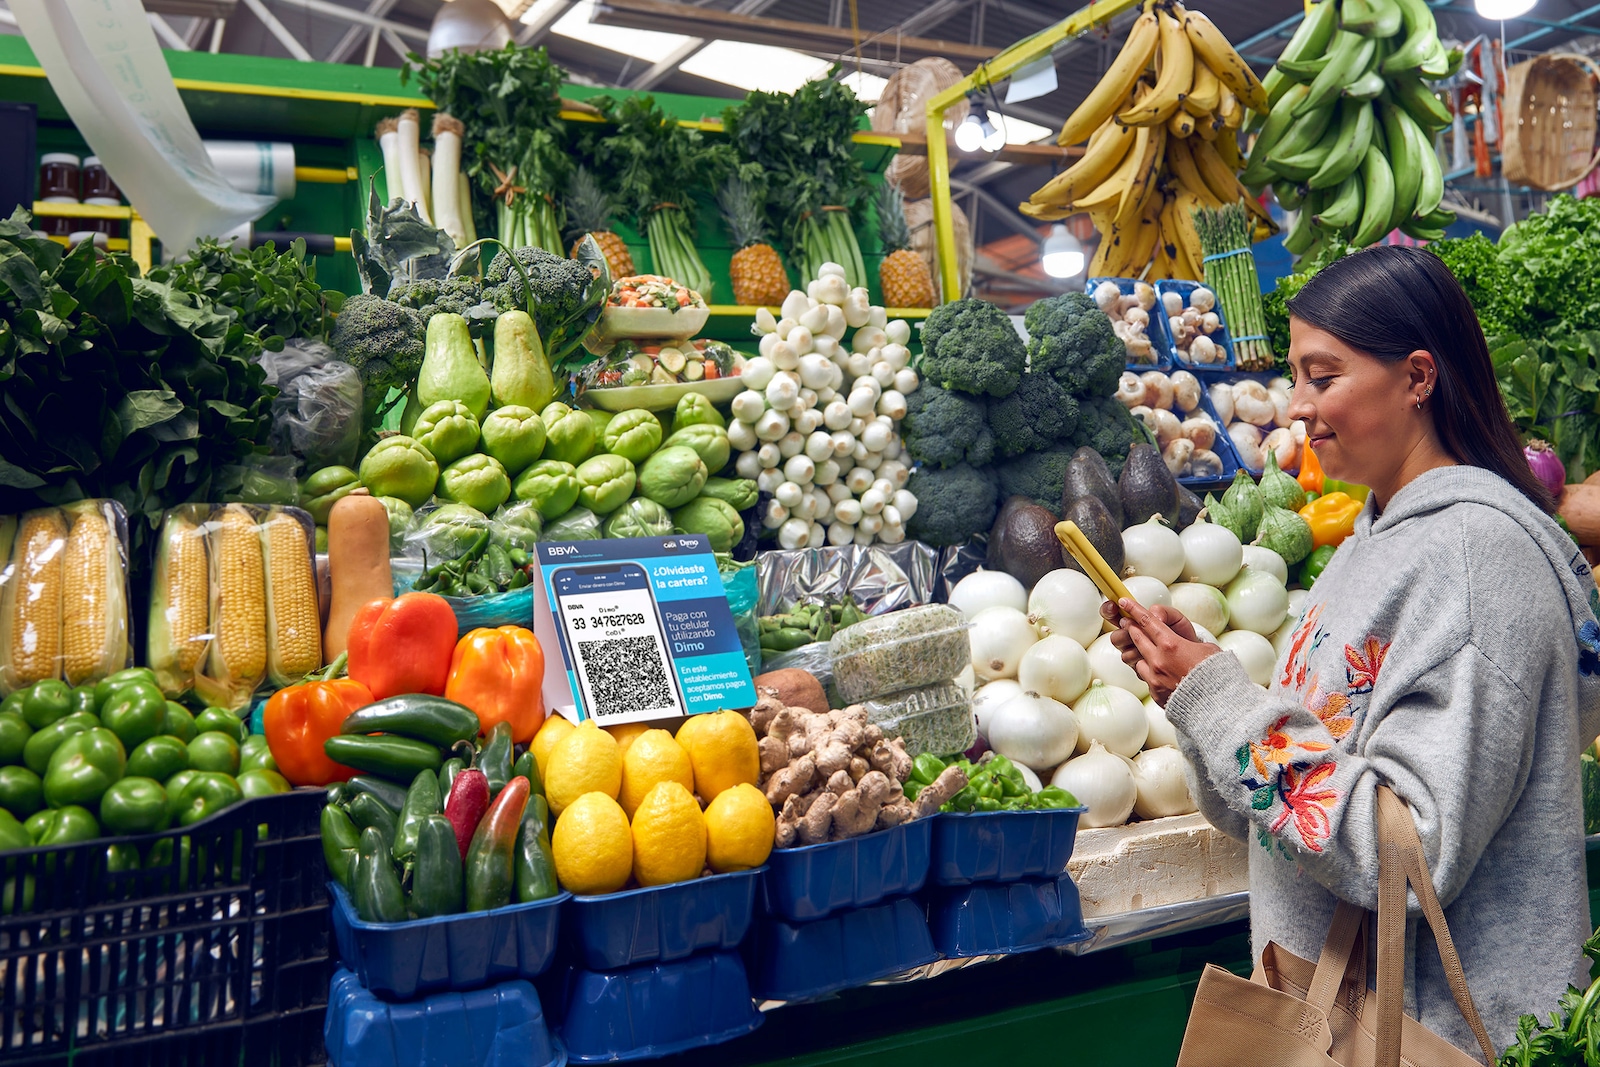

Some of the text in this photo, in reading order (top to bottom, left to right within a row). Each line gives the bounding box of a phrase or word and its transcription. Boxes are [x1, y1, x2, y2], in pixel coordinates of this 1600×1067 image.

[548, 545, 579, 556] BBVA
[653, 564, 705, 577] ¿Olvidaste
[656, 575, 708, 589] la cartera?
[572, 613, 645, 630] 33 347627628
[665, 610, 707, 622] Paga con
[669, 620, 710, 632] tu celular
[671, 628, 715, 641] utilizando
[674, 641, 704, 653] Dimo
[681, 665, 707, 674] En este
[684, 670, 738, 683] establecimiento
[686, 680, 746, 693] aceptamos pagos
[689, 692, 725, 703] con Dimo.
